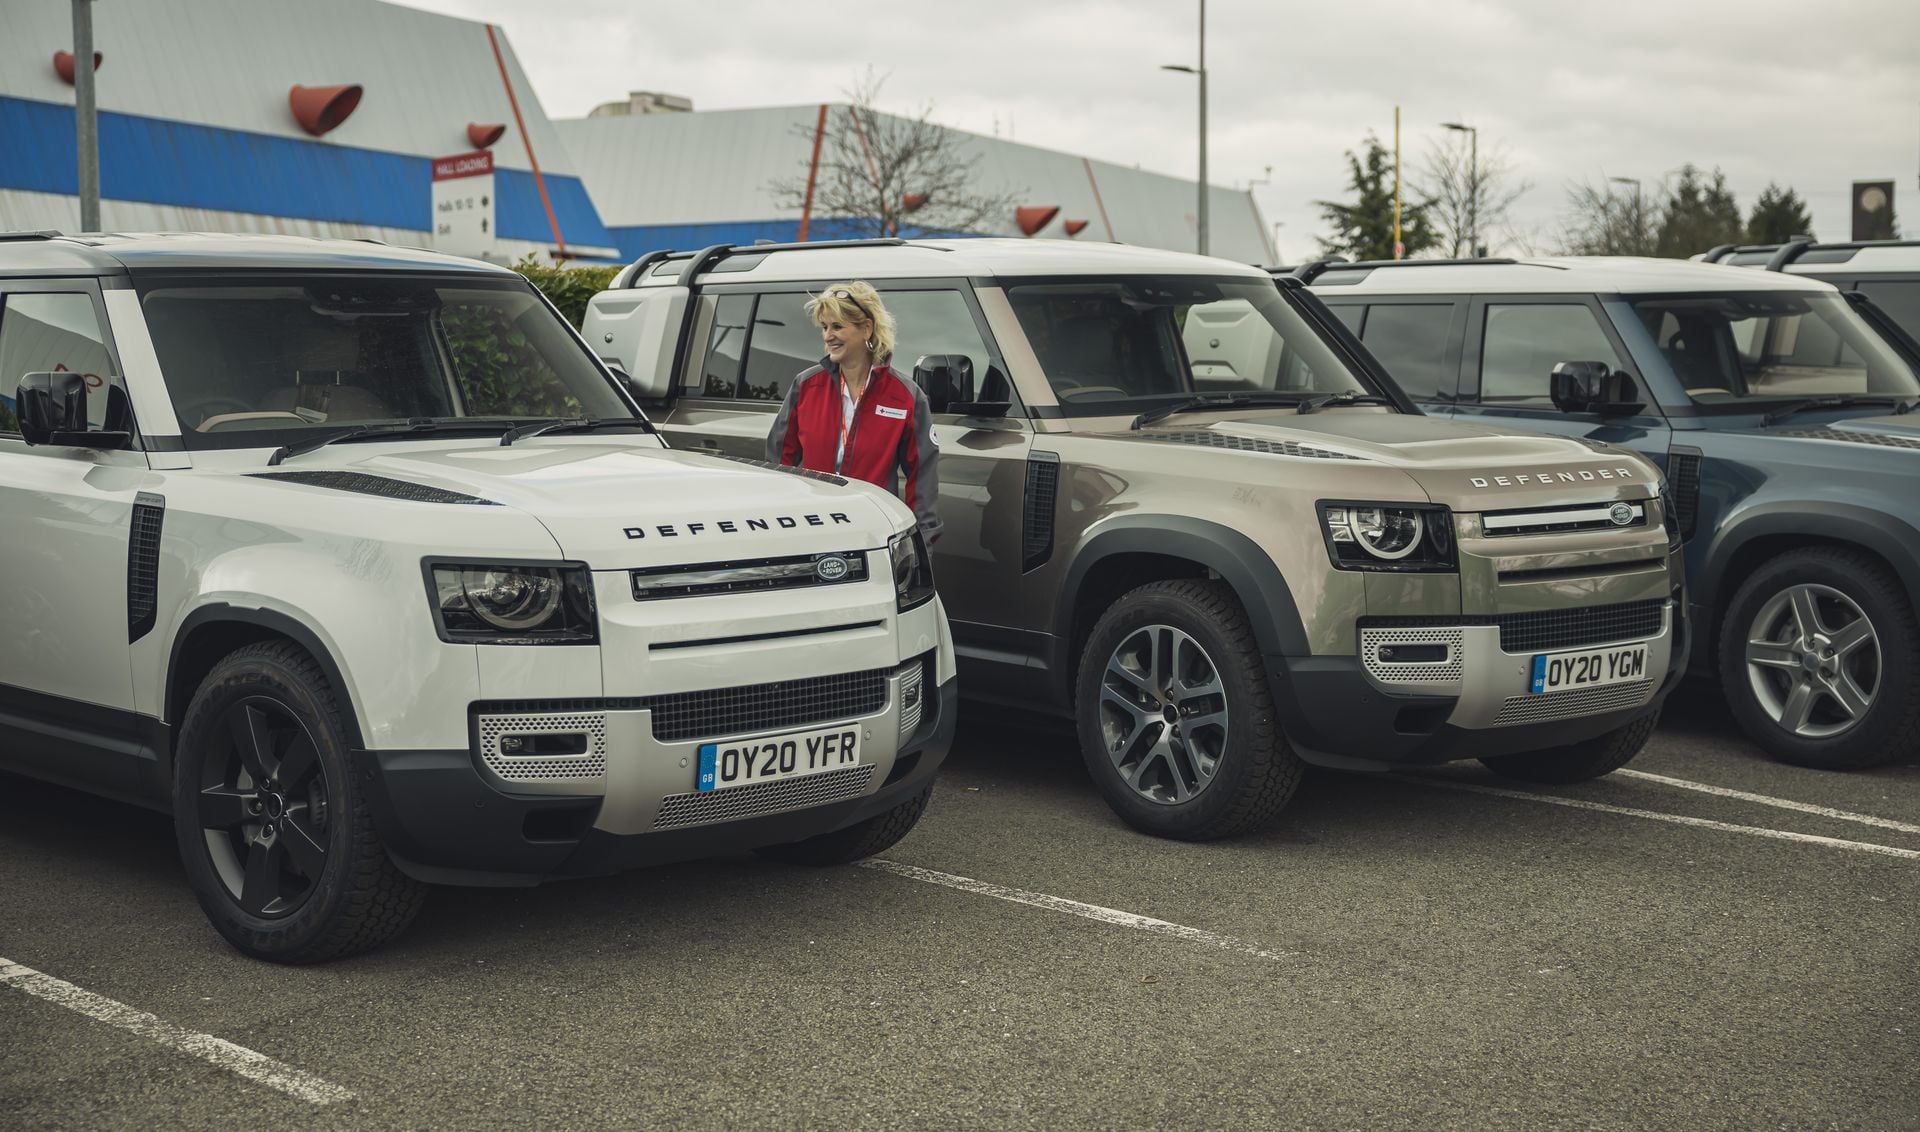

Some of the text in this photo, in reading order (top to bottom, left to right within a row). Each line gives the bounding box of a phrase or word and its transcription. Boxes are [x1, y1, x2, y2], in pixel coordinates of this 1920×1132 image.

[438, 223, 451, 235] Exit
[1470, 467, 1633, 488] DEFENDER
[622, 512, 851, 540] DEFENDER
[825, 567, 843, 575] ROVER
[1548, 649, 1644, 686] OY20 YGM
[721, 731, 856, 782] OY20 YFR
[702, 773, 713, 783] GB
